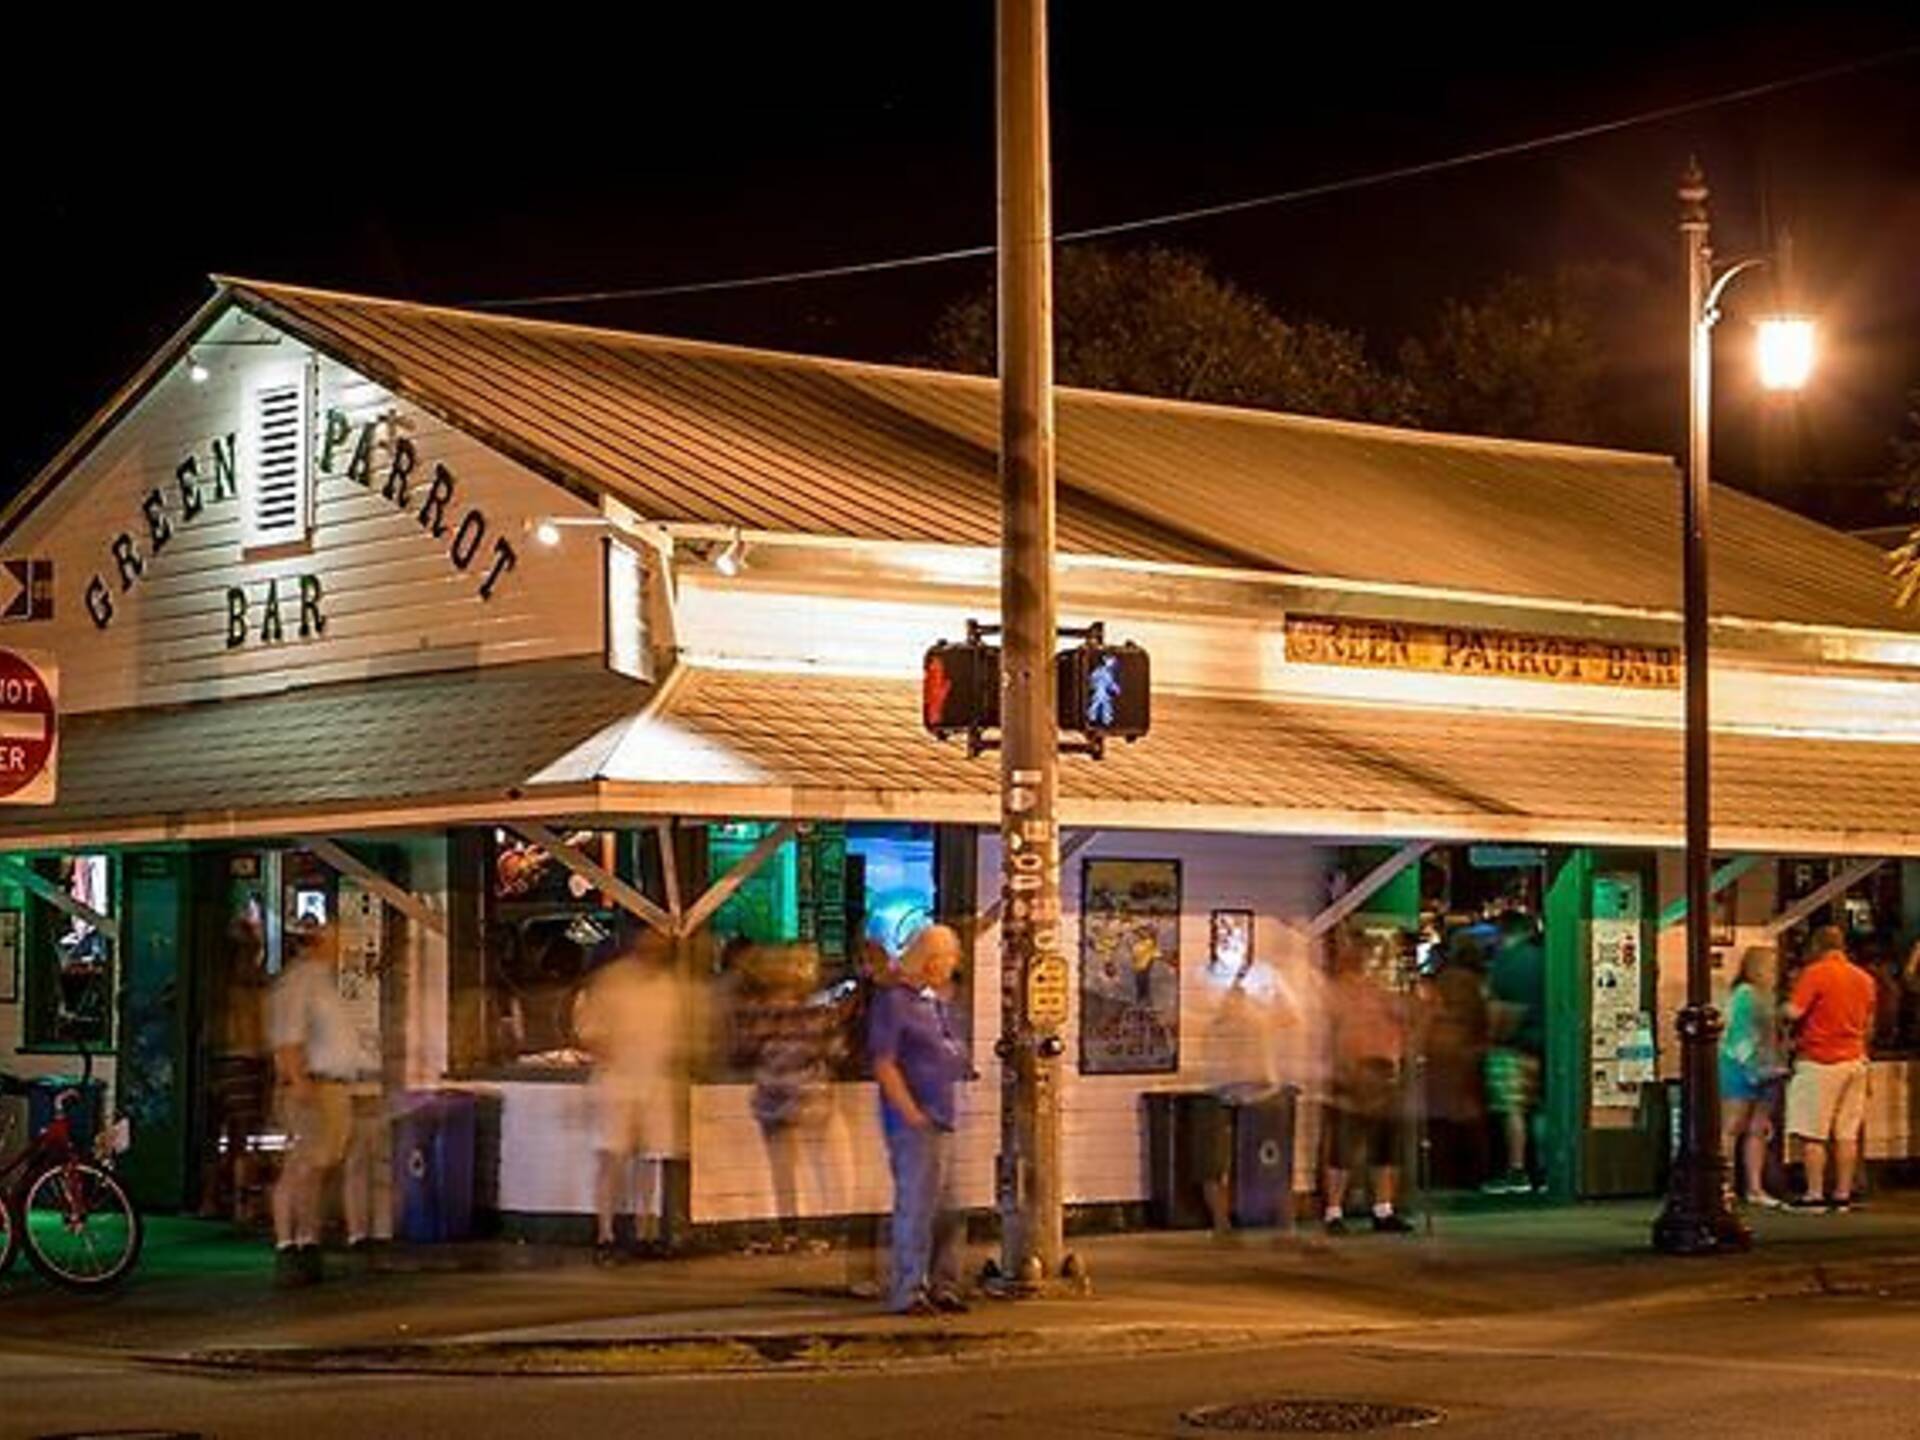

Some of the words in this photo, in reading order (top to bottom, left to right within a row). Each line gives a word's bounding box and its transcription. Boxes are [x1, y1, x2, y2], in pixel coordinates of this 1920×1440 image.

[85, 433, 237, 630] GREEN
[319, 408, 516, 602] PARROT
[227, 574, 326, 649] BAR
[1443, 628, 1583, 678] PARROT
[1607, 644, 1680, 684] BAR
